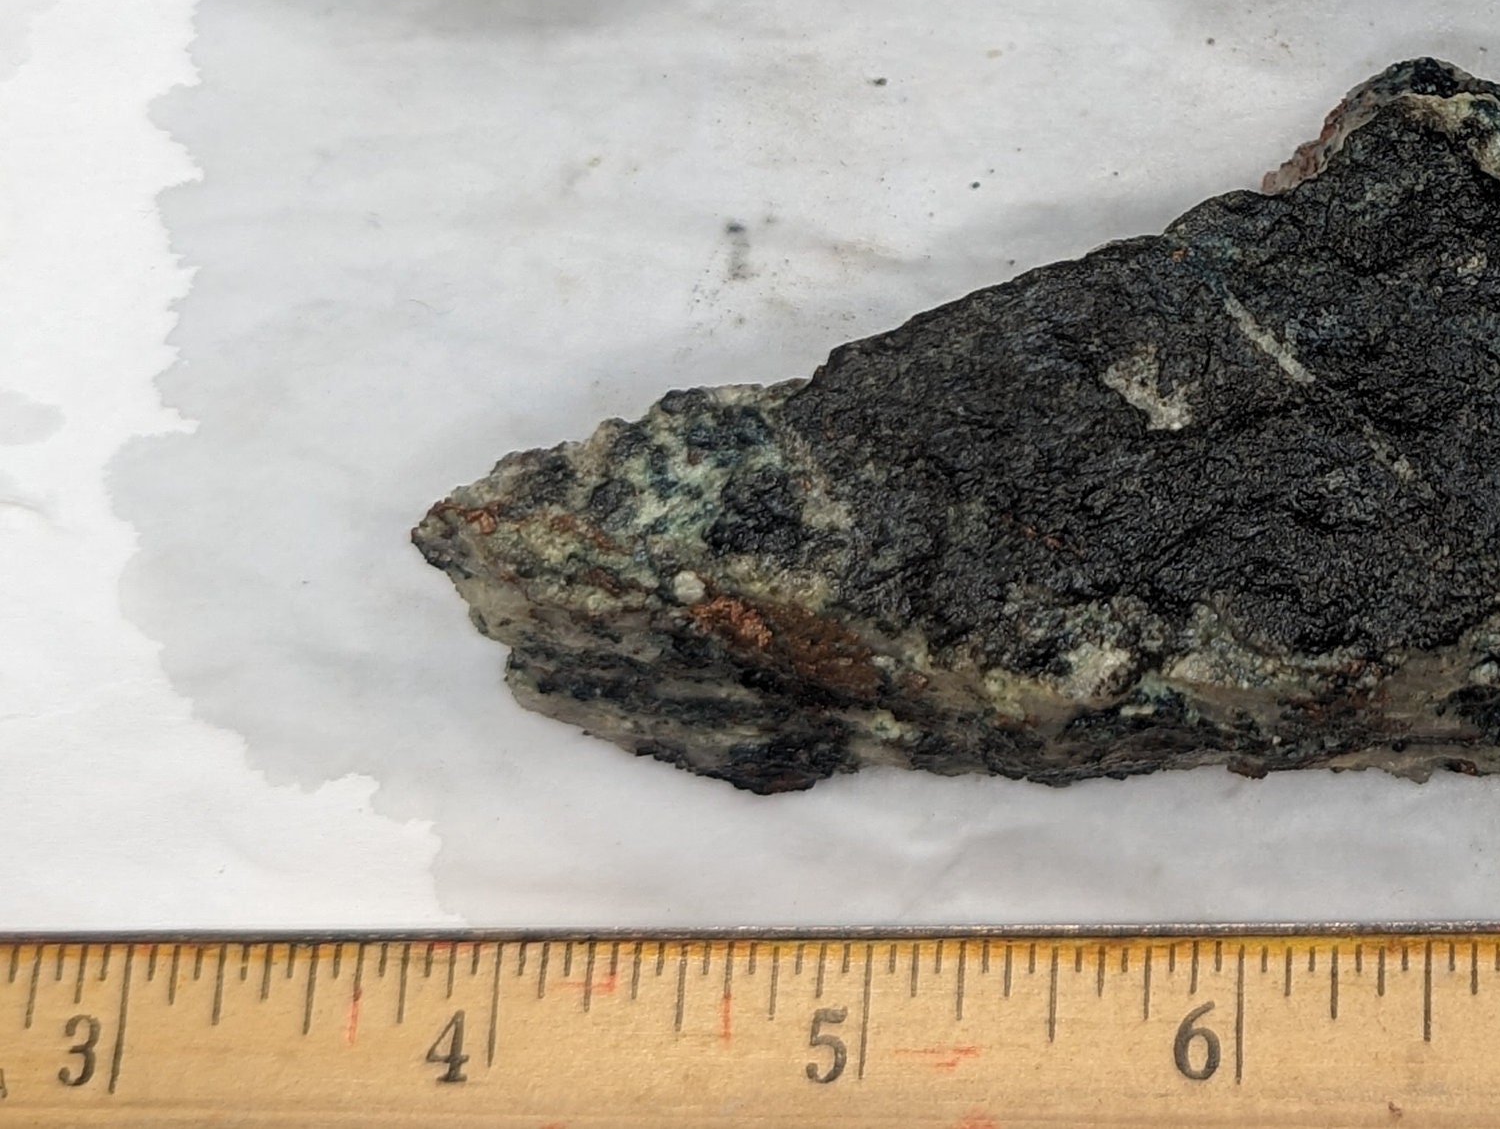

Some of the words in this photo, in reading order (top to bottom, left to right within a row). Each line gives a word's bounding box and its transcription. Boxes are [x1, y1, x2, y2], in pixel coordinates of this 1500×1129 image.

[58, 1014, 102, 1088] 3
[424, 1009, 470, 1084] 4
[804, 1007, 848, 1084] 5
[1172, 1002, 1221, 1081] 6
